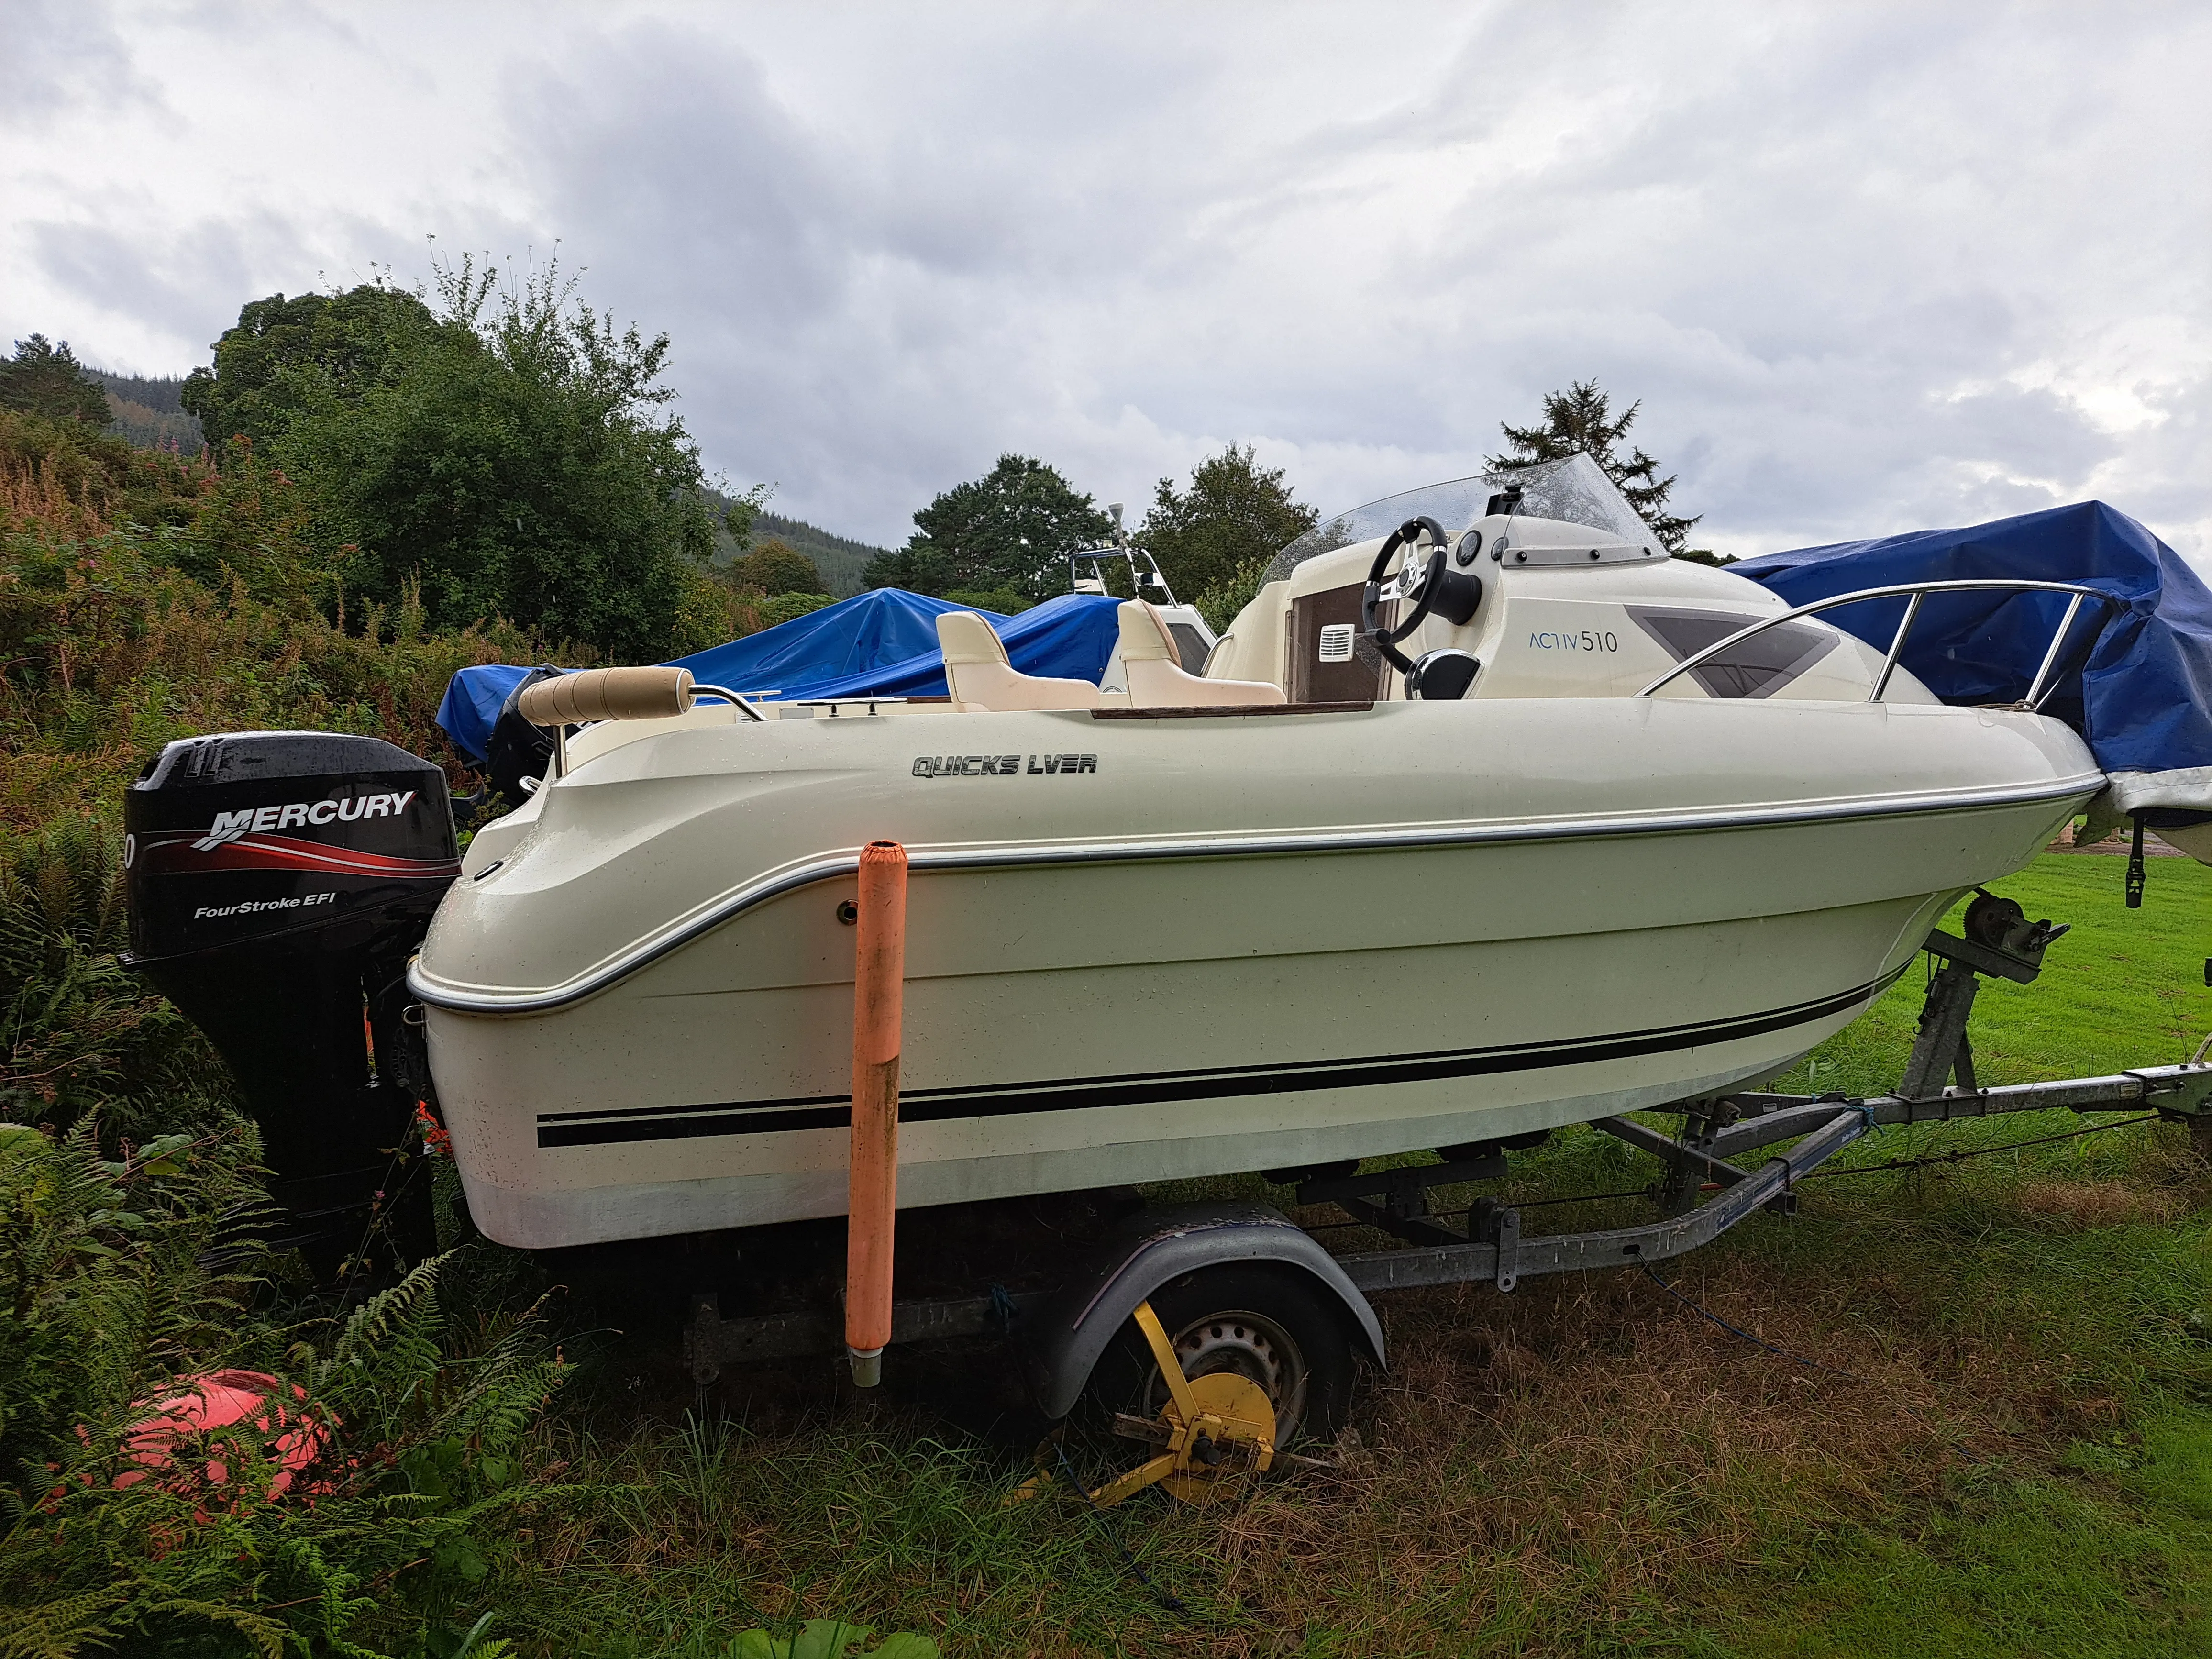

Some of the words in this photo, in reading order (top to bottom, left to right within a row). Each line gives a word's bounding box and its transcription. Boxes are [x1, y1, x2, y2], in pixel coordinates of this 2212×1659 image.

[1582, 631, 1617, 653] 510
[191, 791, 416, 851] MERCURY
[194, 897, 300, 919] FourStroke
[303, 893, 337, 906] EFI
